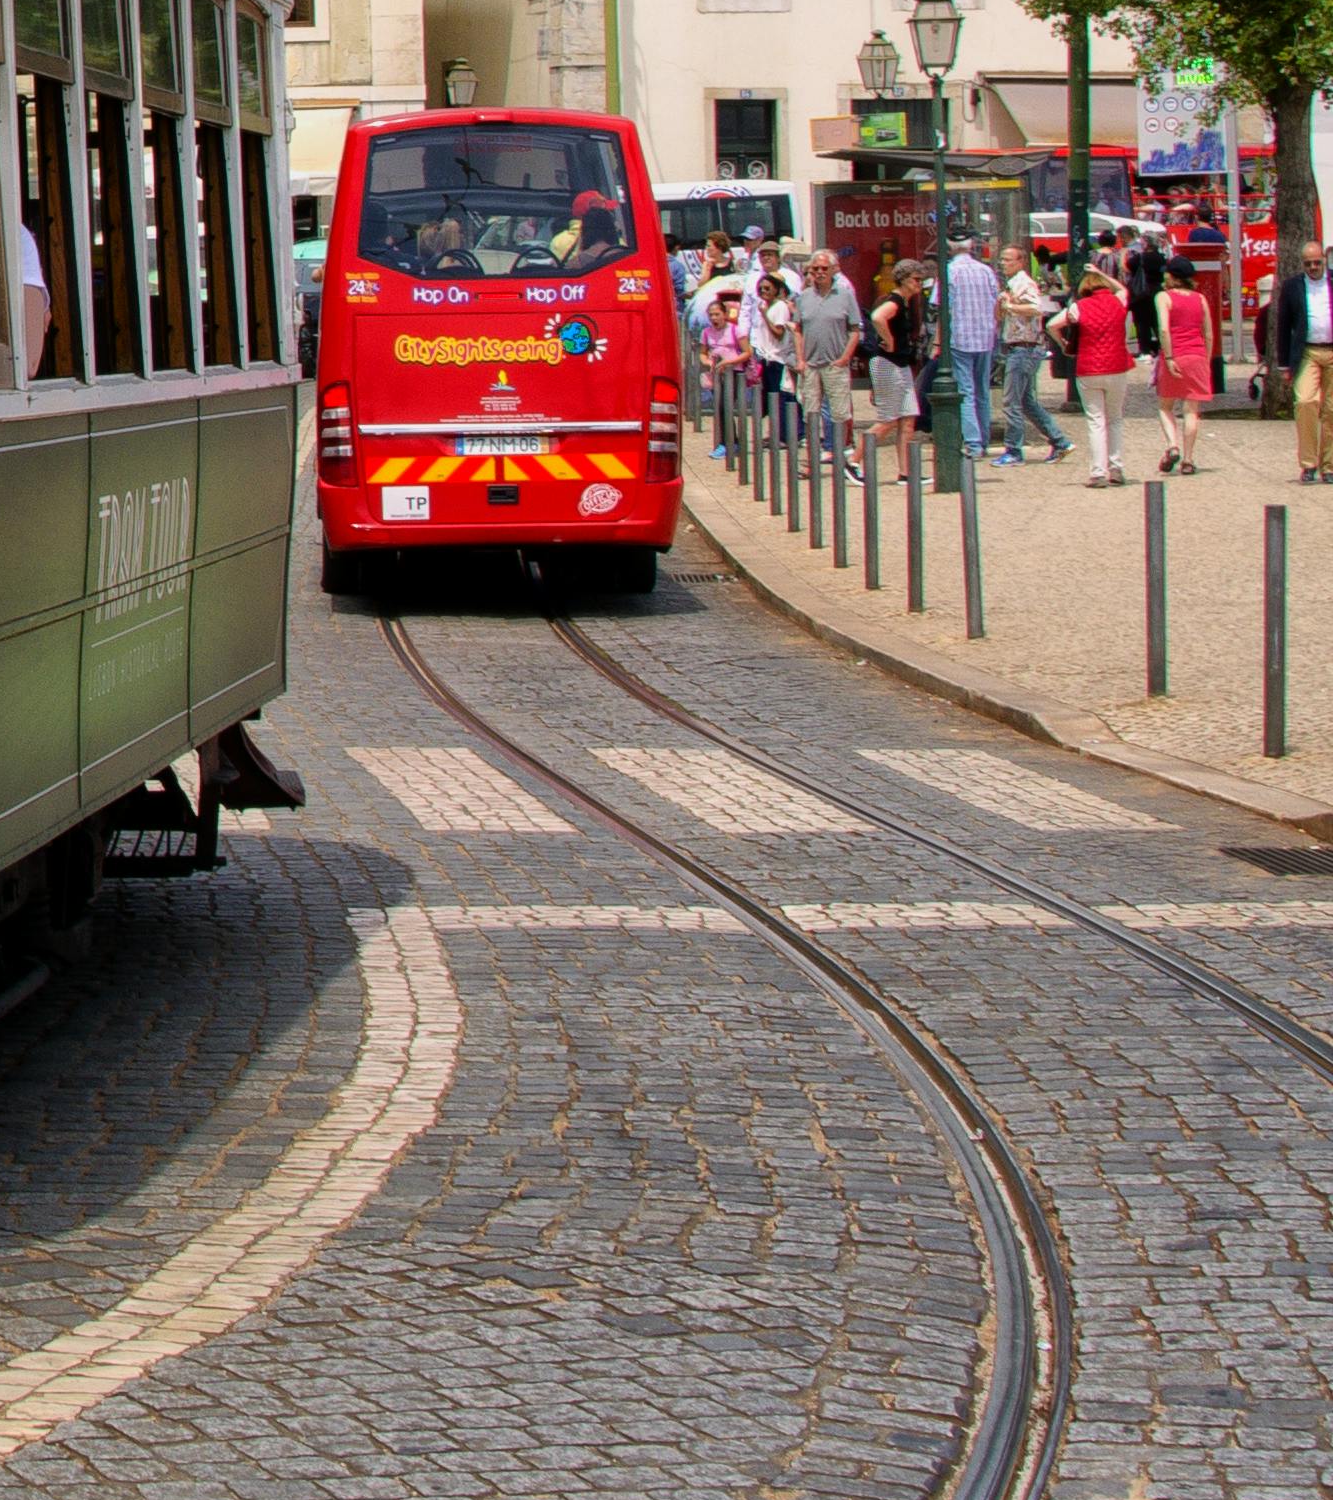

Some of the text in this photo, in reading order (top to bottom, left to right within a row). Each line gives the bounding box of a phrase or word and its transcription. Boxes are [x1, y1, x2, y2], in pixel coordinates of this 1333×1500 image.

[834, 209, 871, 228] Bock
[874, 211, 890, 227] to
[413, 286, 470, 304] Hop On
[526, 284, 586, 304] Hop Off
[395, 334, 563, 366] CitySightseeing
[405, 496, 428, 511] TP
[95, 476, 191, 625] TRAM TOUR
